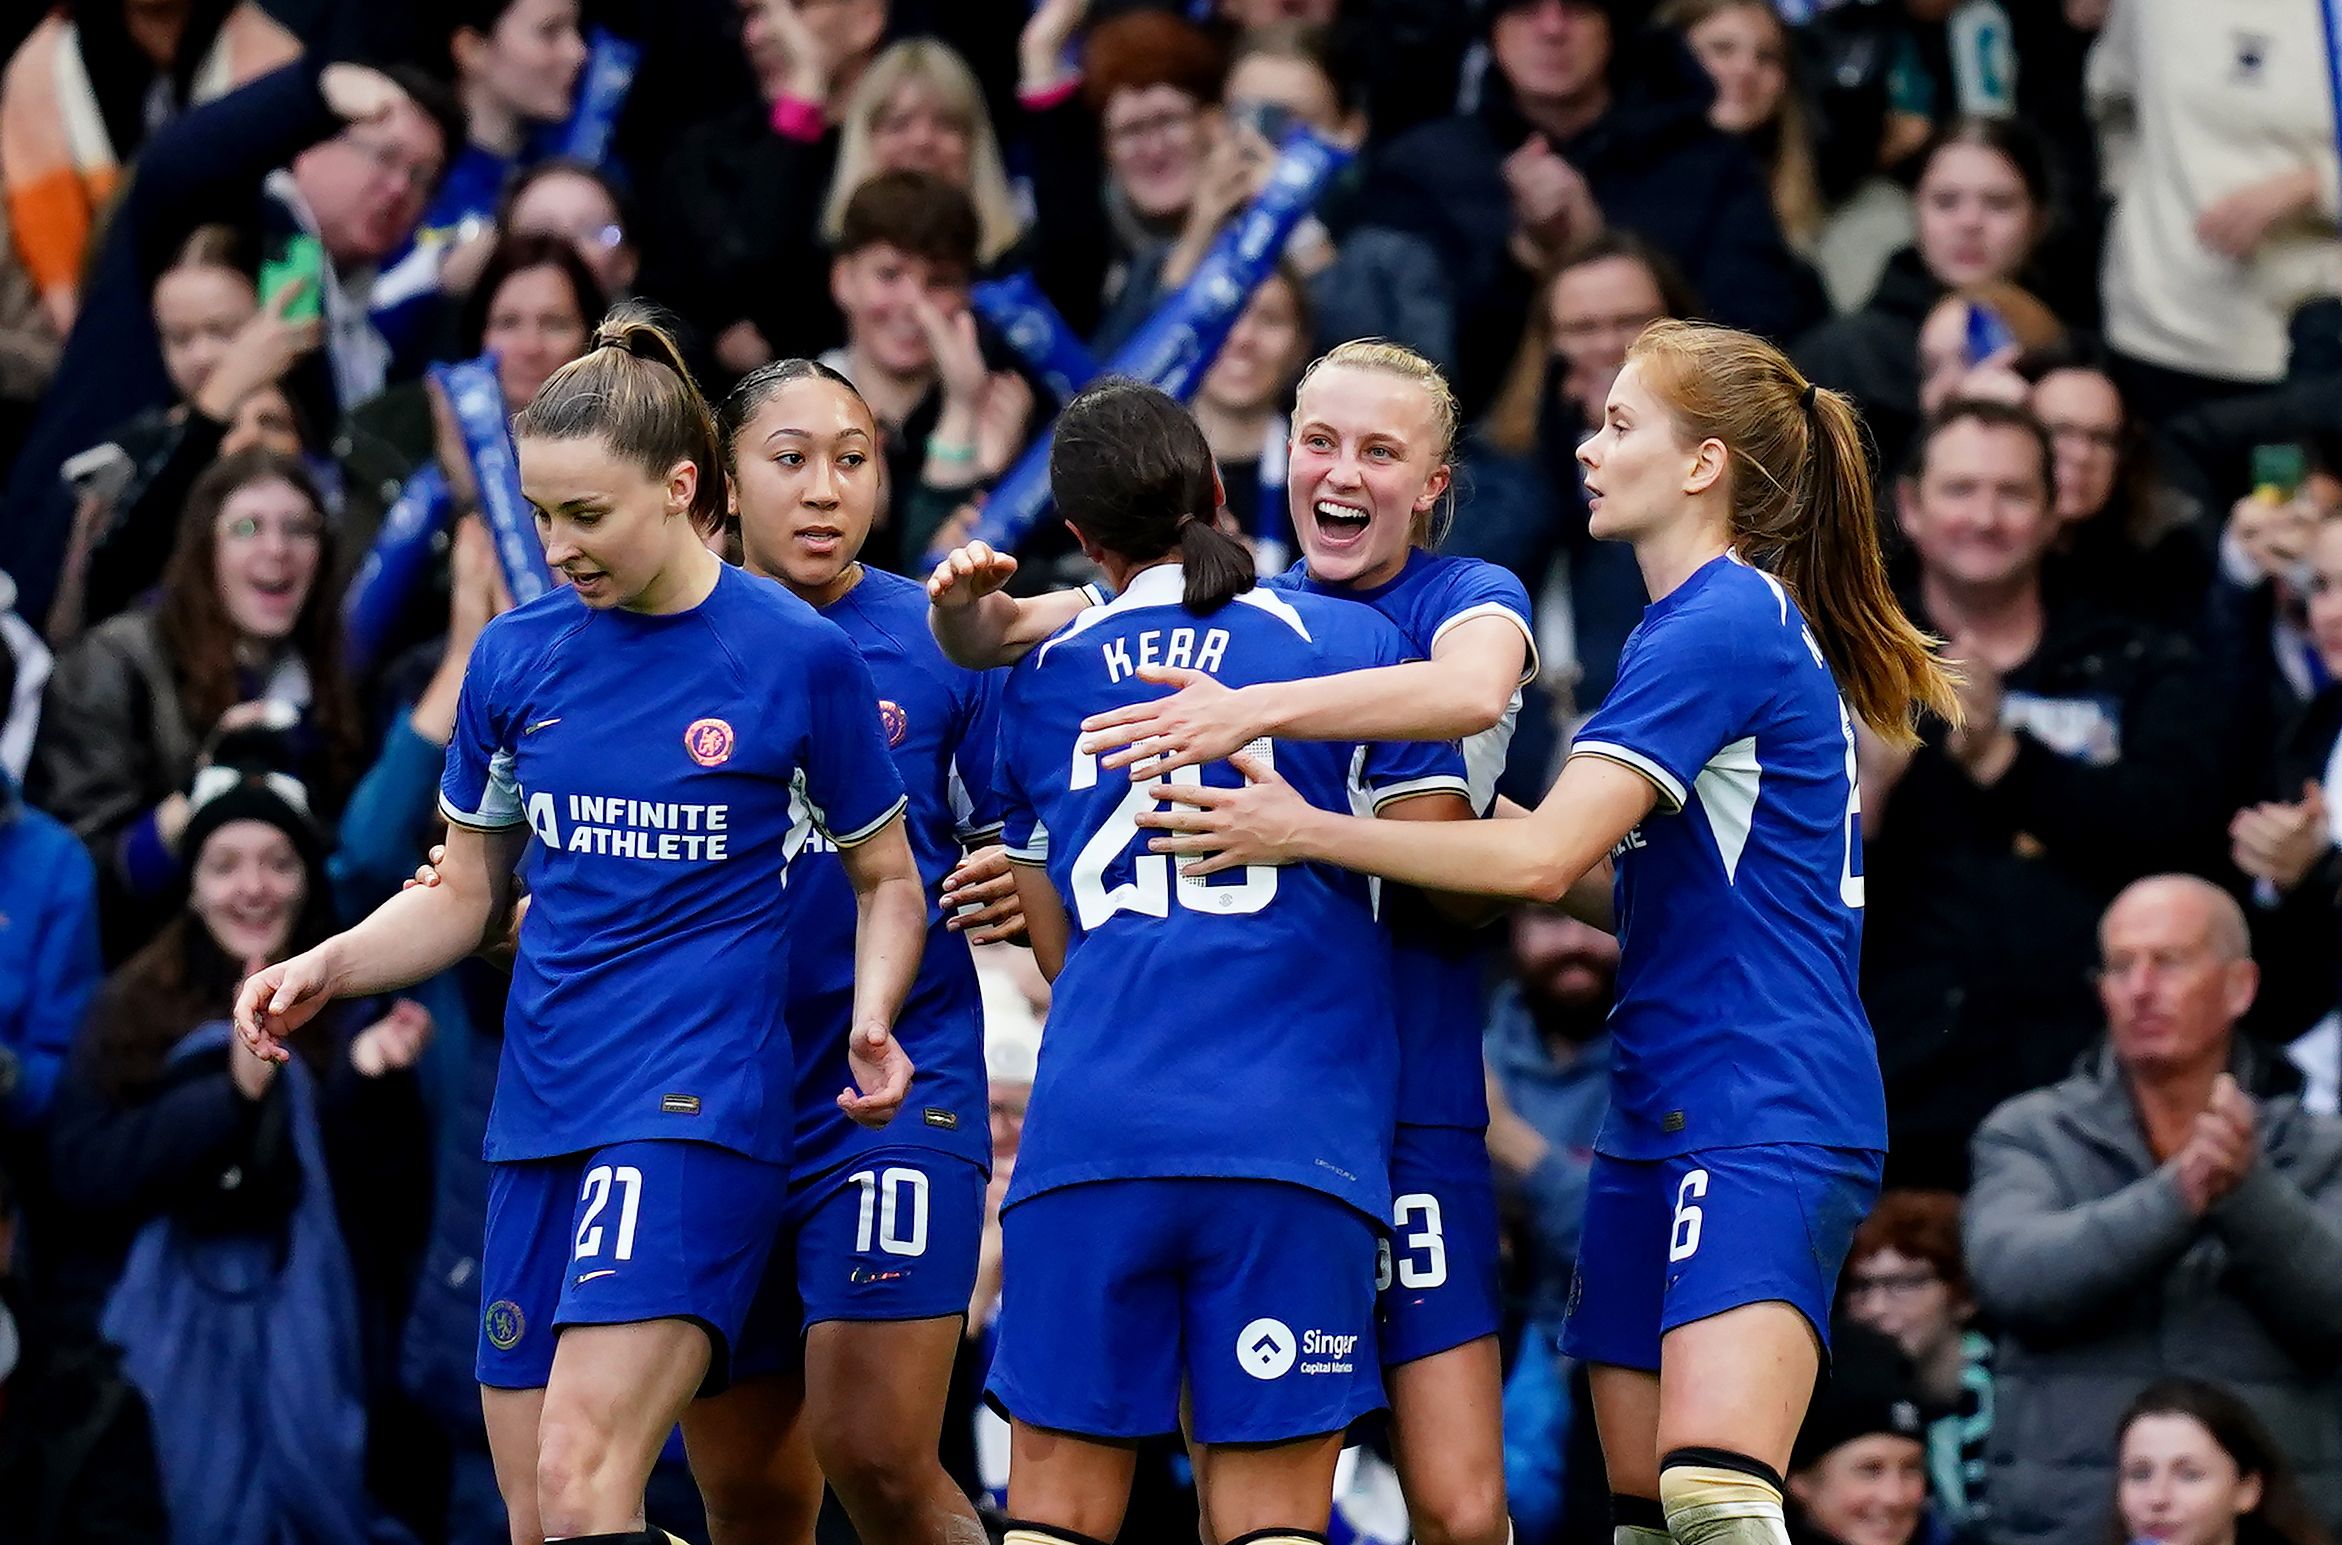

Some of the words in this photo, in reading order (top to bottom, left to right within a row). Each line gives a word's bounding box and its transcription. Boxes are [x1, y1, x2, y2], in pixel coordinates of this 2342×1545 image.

[1102, 627, 1230, 684] KERR
[568, 826, 728, 861] ATHLETE
[569, 794, 729, 831] INFINITE
[574, 1165, 643, 1263] 21
[848, 1167, 929, 1257] 10
[1376, 1193, 1447, 1291] 3
[1669, 1169, 1709, 1262] 6
